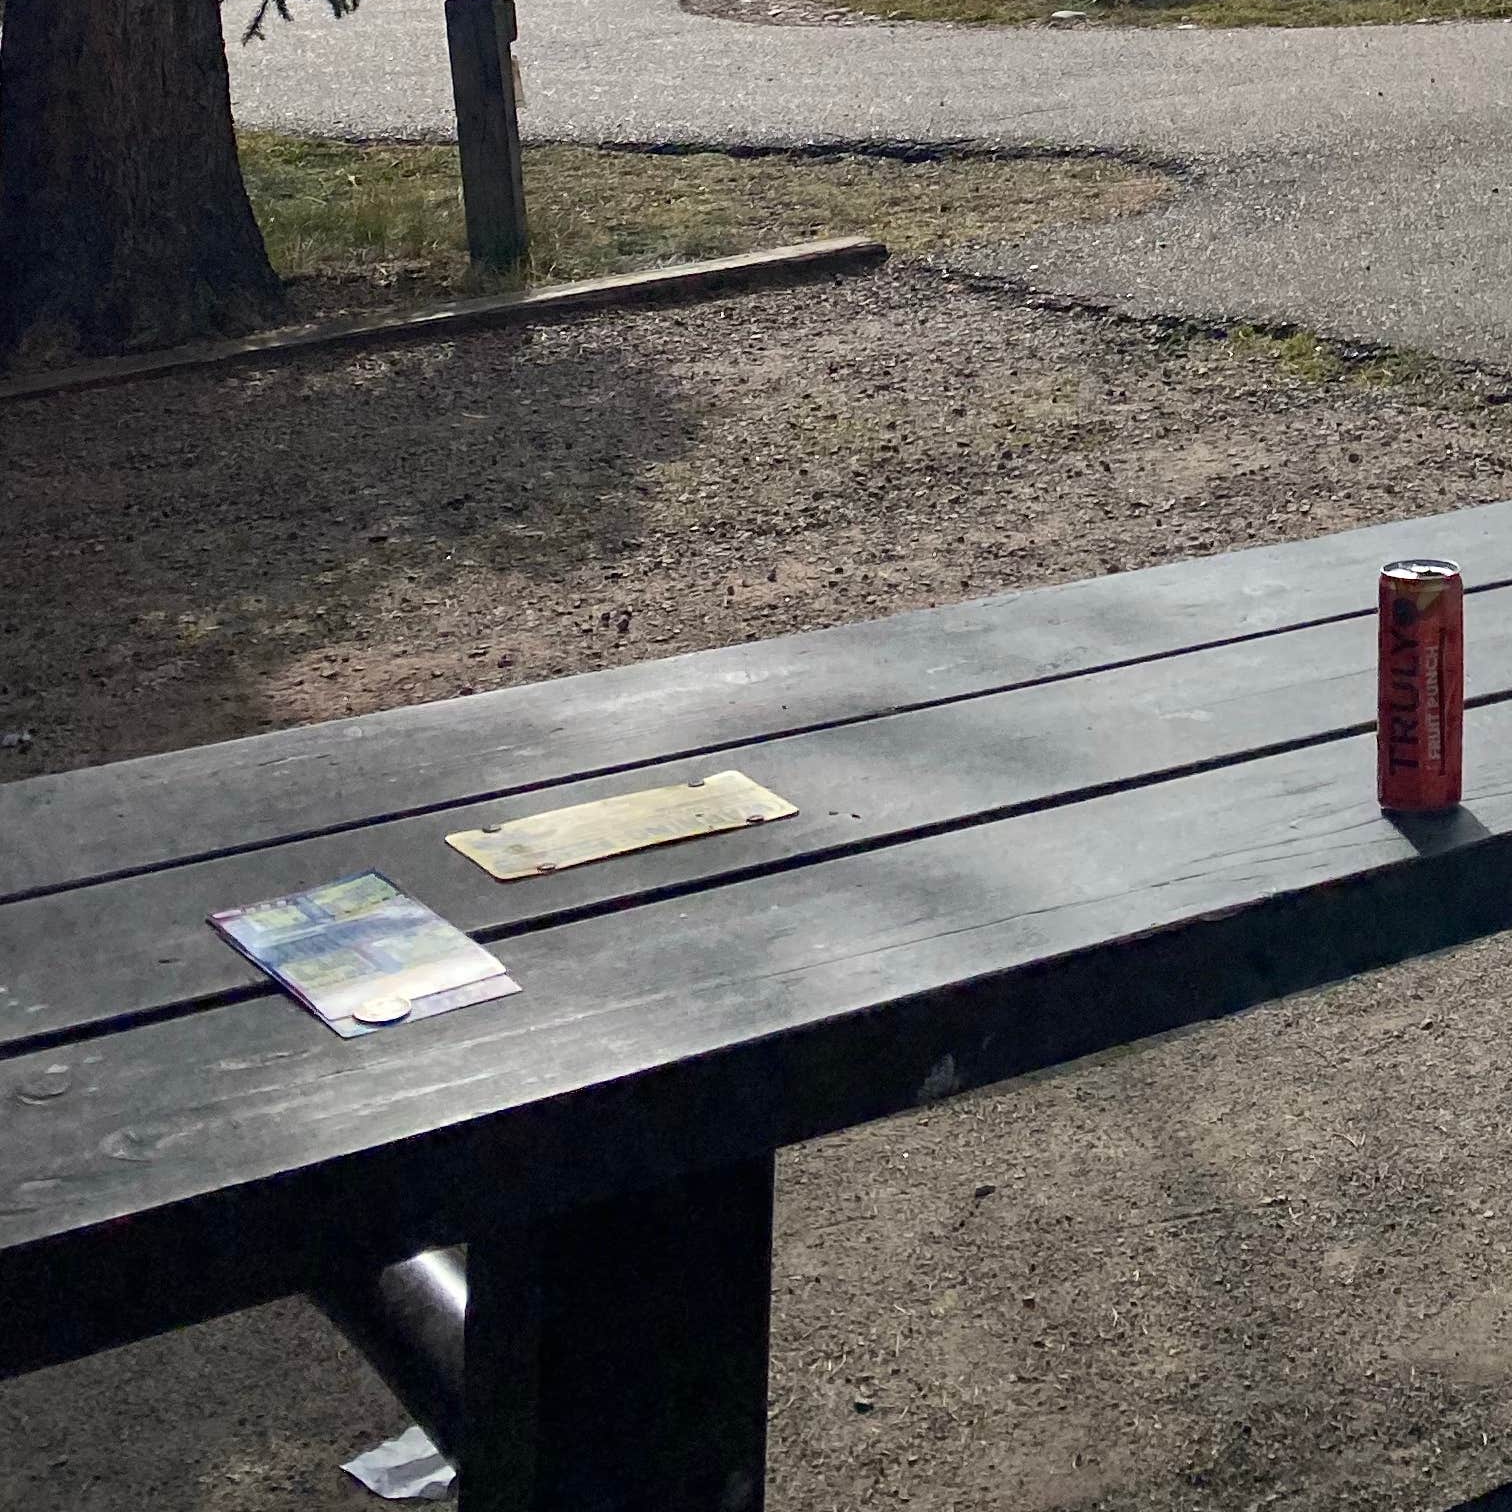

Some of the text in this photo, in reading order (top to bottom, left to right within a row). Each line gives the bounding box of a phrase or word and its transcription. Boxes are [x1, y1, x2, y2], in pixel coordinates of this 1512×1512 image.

[1389, 632, 1420, 775] TRULY
[1426, 646, 1441, 761] FRUIT PUNCH
